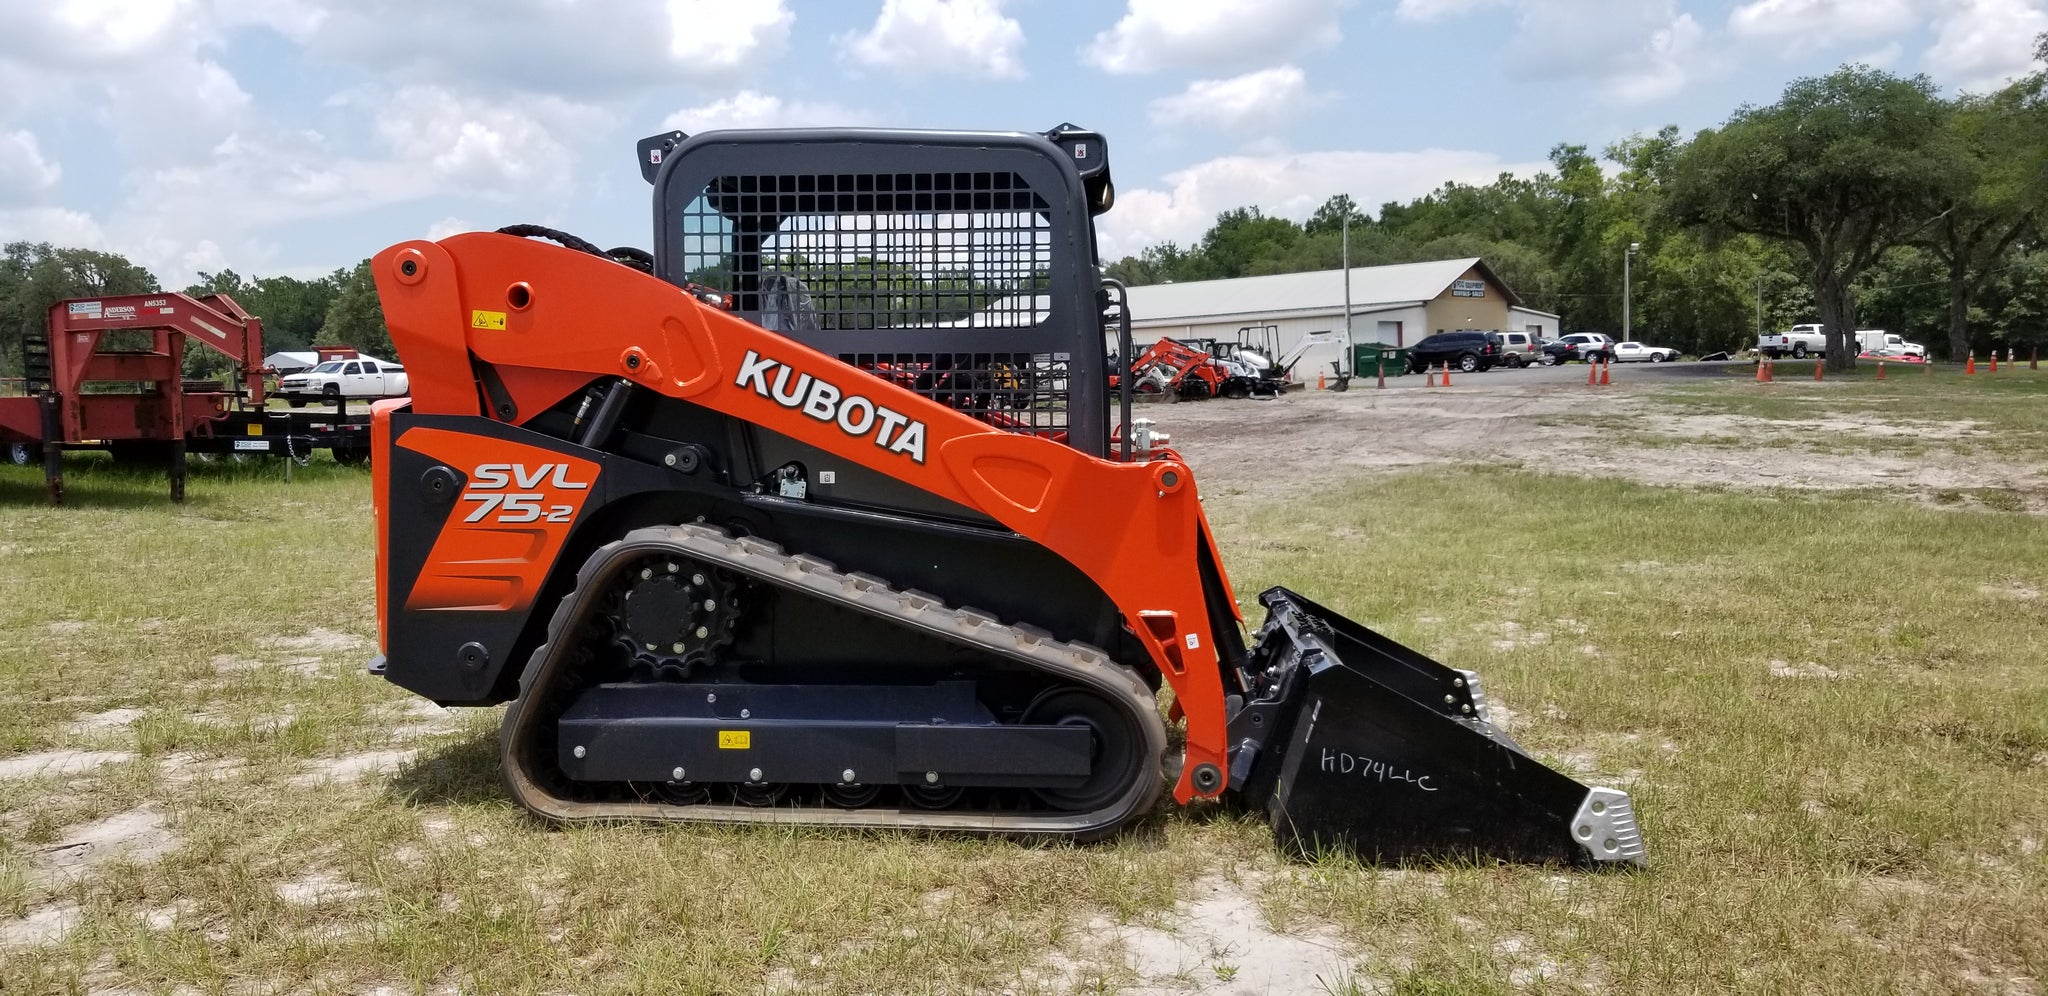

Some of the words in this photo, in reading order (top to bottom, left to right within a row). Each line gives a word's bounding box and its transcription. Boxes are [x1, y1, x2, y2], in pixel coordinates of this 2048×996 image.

[104, 305, 136, 318] ANDERSON
[735, 350, 926, 463] KUBOTA
[469, 463, 588, 489] SVL
[463, 493, 573, 523] 75-2
